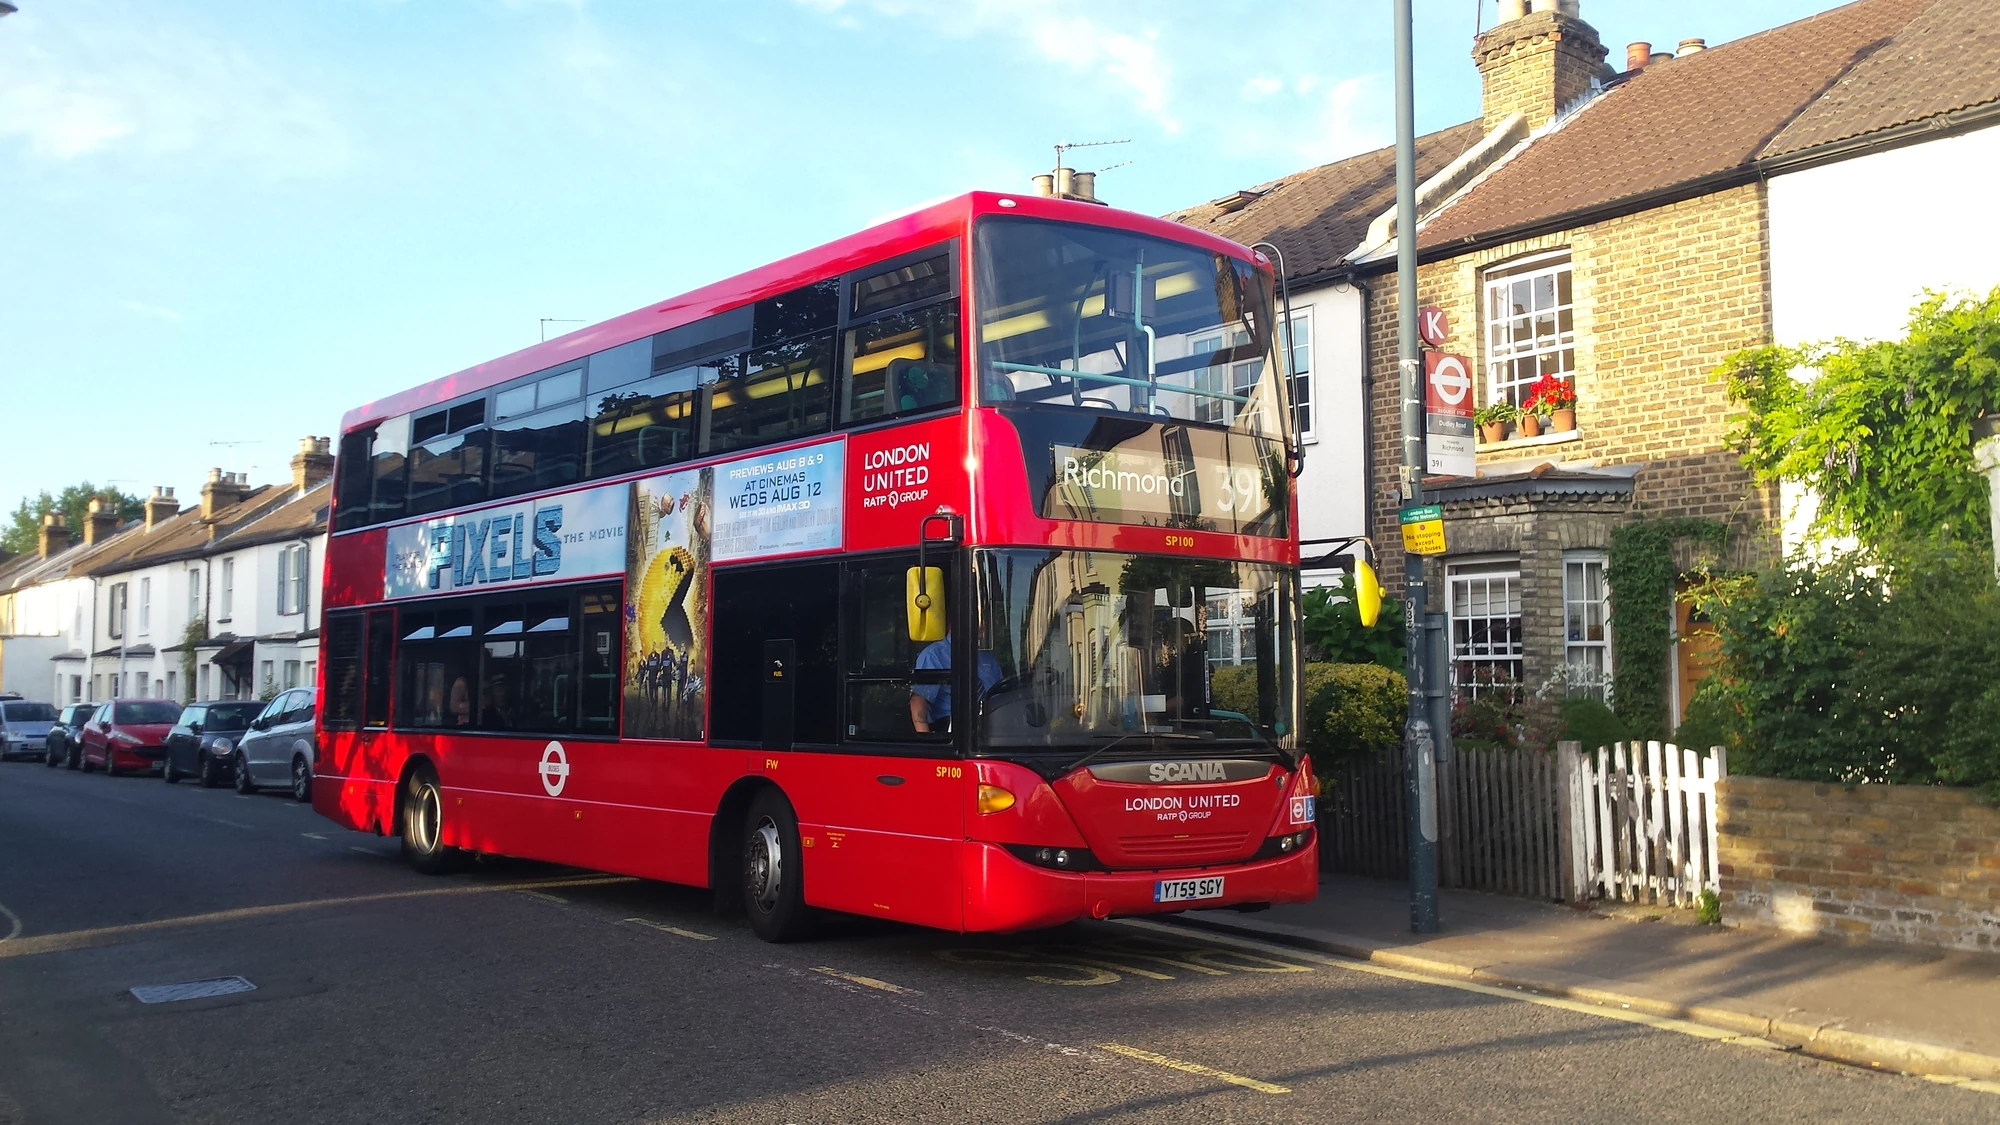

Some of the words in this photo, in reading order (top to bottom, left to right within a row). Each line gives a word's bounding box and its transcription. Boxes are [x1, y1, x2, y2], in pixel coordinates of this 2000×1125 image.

[1426, 311, 1446, 339] K
[1438, 420, 1455, 428] Dudley
[1455, 421, 1467, 429] Road
[864, 442, 930, 471] LONDON
[1442, 444, 1464, 453] Richmond
[729, 463, 774, 480] PREVIEWS
[776, 458, 796, 472] AUG
[798, 457, 806, 468] 8
[807, 455, 815, 466] &
[816, 453, 824, 464] 9
[1431, 459, 1443, 468] 391
[744, 480, 757, 492] AT
[759, 472, 806, 490] CINEMAS
[863, 465, 929, 492] UNITED
[1063, 456, 1184, 497] Richmond
[729, 491, 767, 509] WEDS
[771, 485, 800, 503] AUG
[806, 481, 822, 497] 12
[863, 495, 887, 508] RATP
[900, 489, 929, 503] GROUP
[1215, 465, 1262, 514] 391
[776, 502, 797, 513] IMAX
[798, 500, 811, 510] 3D
[1420, 512, 1438, 520] Network
[563, 532, 584, 544] THE
[588, 526, 624, 541] MOVIE
[1165, 535, 1194, 548] SP100
[1415, 539, 1434, 547] except
[1416, 531, 1441, 540] stopping
[428, 504, 563, 590] PIXELS
[766, 758, 779, 771] FW
[936, 766, 962, 779] SP100
[1148, 762, 1227, 782] SCANIA
[1125, 796, 1183, 811] LONDON
[1188, 794, 1241, 809] UNITED
[1157, 812, 1178, 821] RATP
[1188, 811, 1212, 820] GROUP
[1163, 880, 1197, 899] YT59
[1199, 878, 1223, 896] SGY
